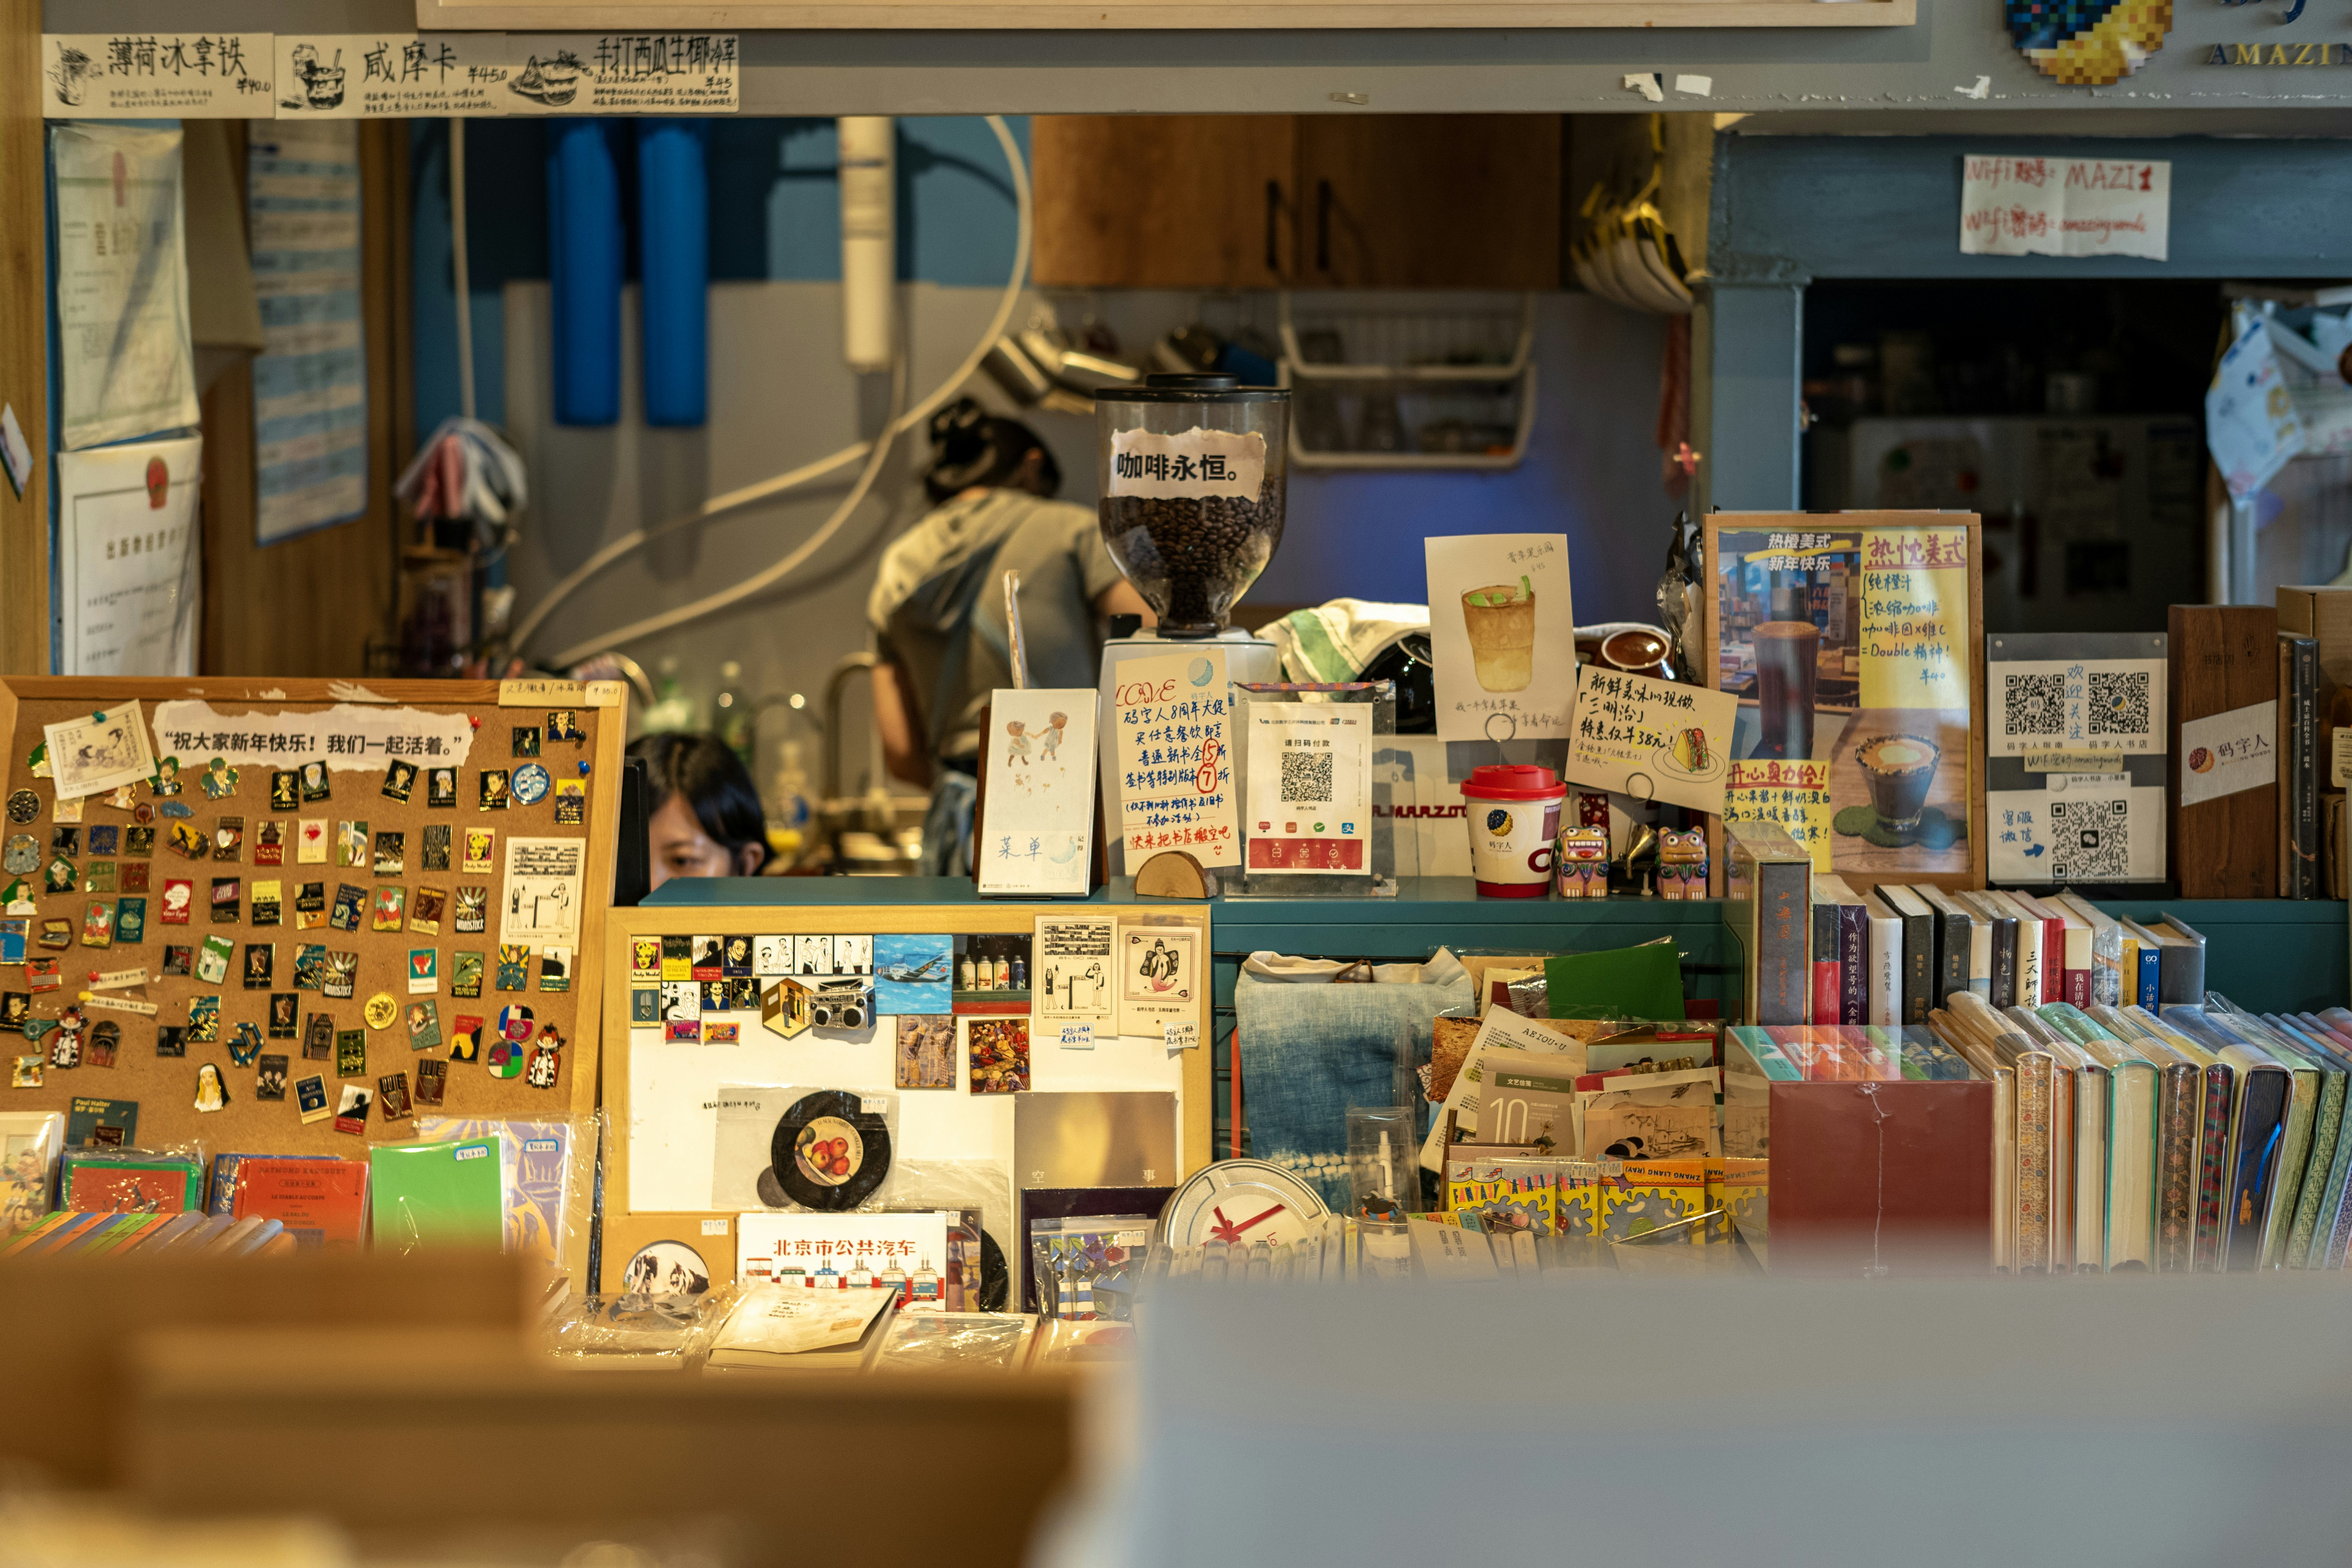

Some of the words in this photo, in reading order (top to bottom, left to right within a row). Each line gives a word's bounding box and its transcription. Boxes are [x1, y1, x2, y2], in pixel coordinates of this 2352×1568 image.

[107, 37, 248, 77] 薄荷冰拿铁
[363, 42, 457, 85] 咸摩卡
[1117, 453, 1236, 481] 咖啡永恒。
[1768, 533, 1831, 549] 热橙美式
[1507, 542, 1553, 564] 青苹果乐园
[1768, 555, 1831, 572] 新年快乐
[1868, 573, 1911, 592] 纯橙汁
[1868, 599, 1939, 616] 浓缩咖啡
[1871, 642, 1911, 658] Double
[1191, 691, 1213, 700] 码字人
[2065, 664, 2084, 740] 欢迎关注
[1124, 699, 1227, 724] 码字人8周年大促
[1580, 692, 1644, 723] 「三明治」
[1285, 739, 1329, 747] 请扫码付款
[2089, 740, 2147, 749] 码字人书店
[2217, 734, 2269, 758] 码字人
[2250, 749, 2271, 758] WORDS
[2003, 810, 2033, 826] 客服
[1077, 836, 1084, 851] 记得
[1130, 825, 1231, 850] 快来把书店搬空吧
[1999, 828, 2032, 844] 微信
[998, 836, 1042, 861] 菜单
[1489, 841, 1512, 849] 码字人
[457, 919, 484, 931] WOODSTOCK
[1999, 947, 2012, 976] 物色
[324, 984, 352, 996] WOODSTOCK
[2074, 973, 2084, 1010] 我在清华
[1507, 1078, 1532, 1087] 文艺信笺
[76, 1098, 89, 1107] Paul
[1032, 1170, 1044, 1183] 空
[1143, 1169, 1156, 1182] 事
[1648, 1169, 1671, 1178] LIANG
[1673, 1171, 1700, 1181] ZHANG
[1453, 1183, 1500, 1204] FANTASY
[1506, 1173, 1552, 1195] FANATIC
[773, 1239, 916, 1257] 北京市公共汽车
